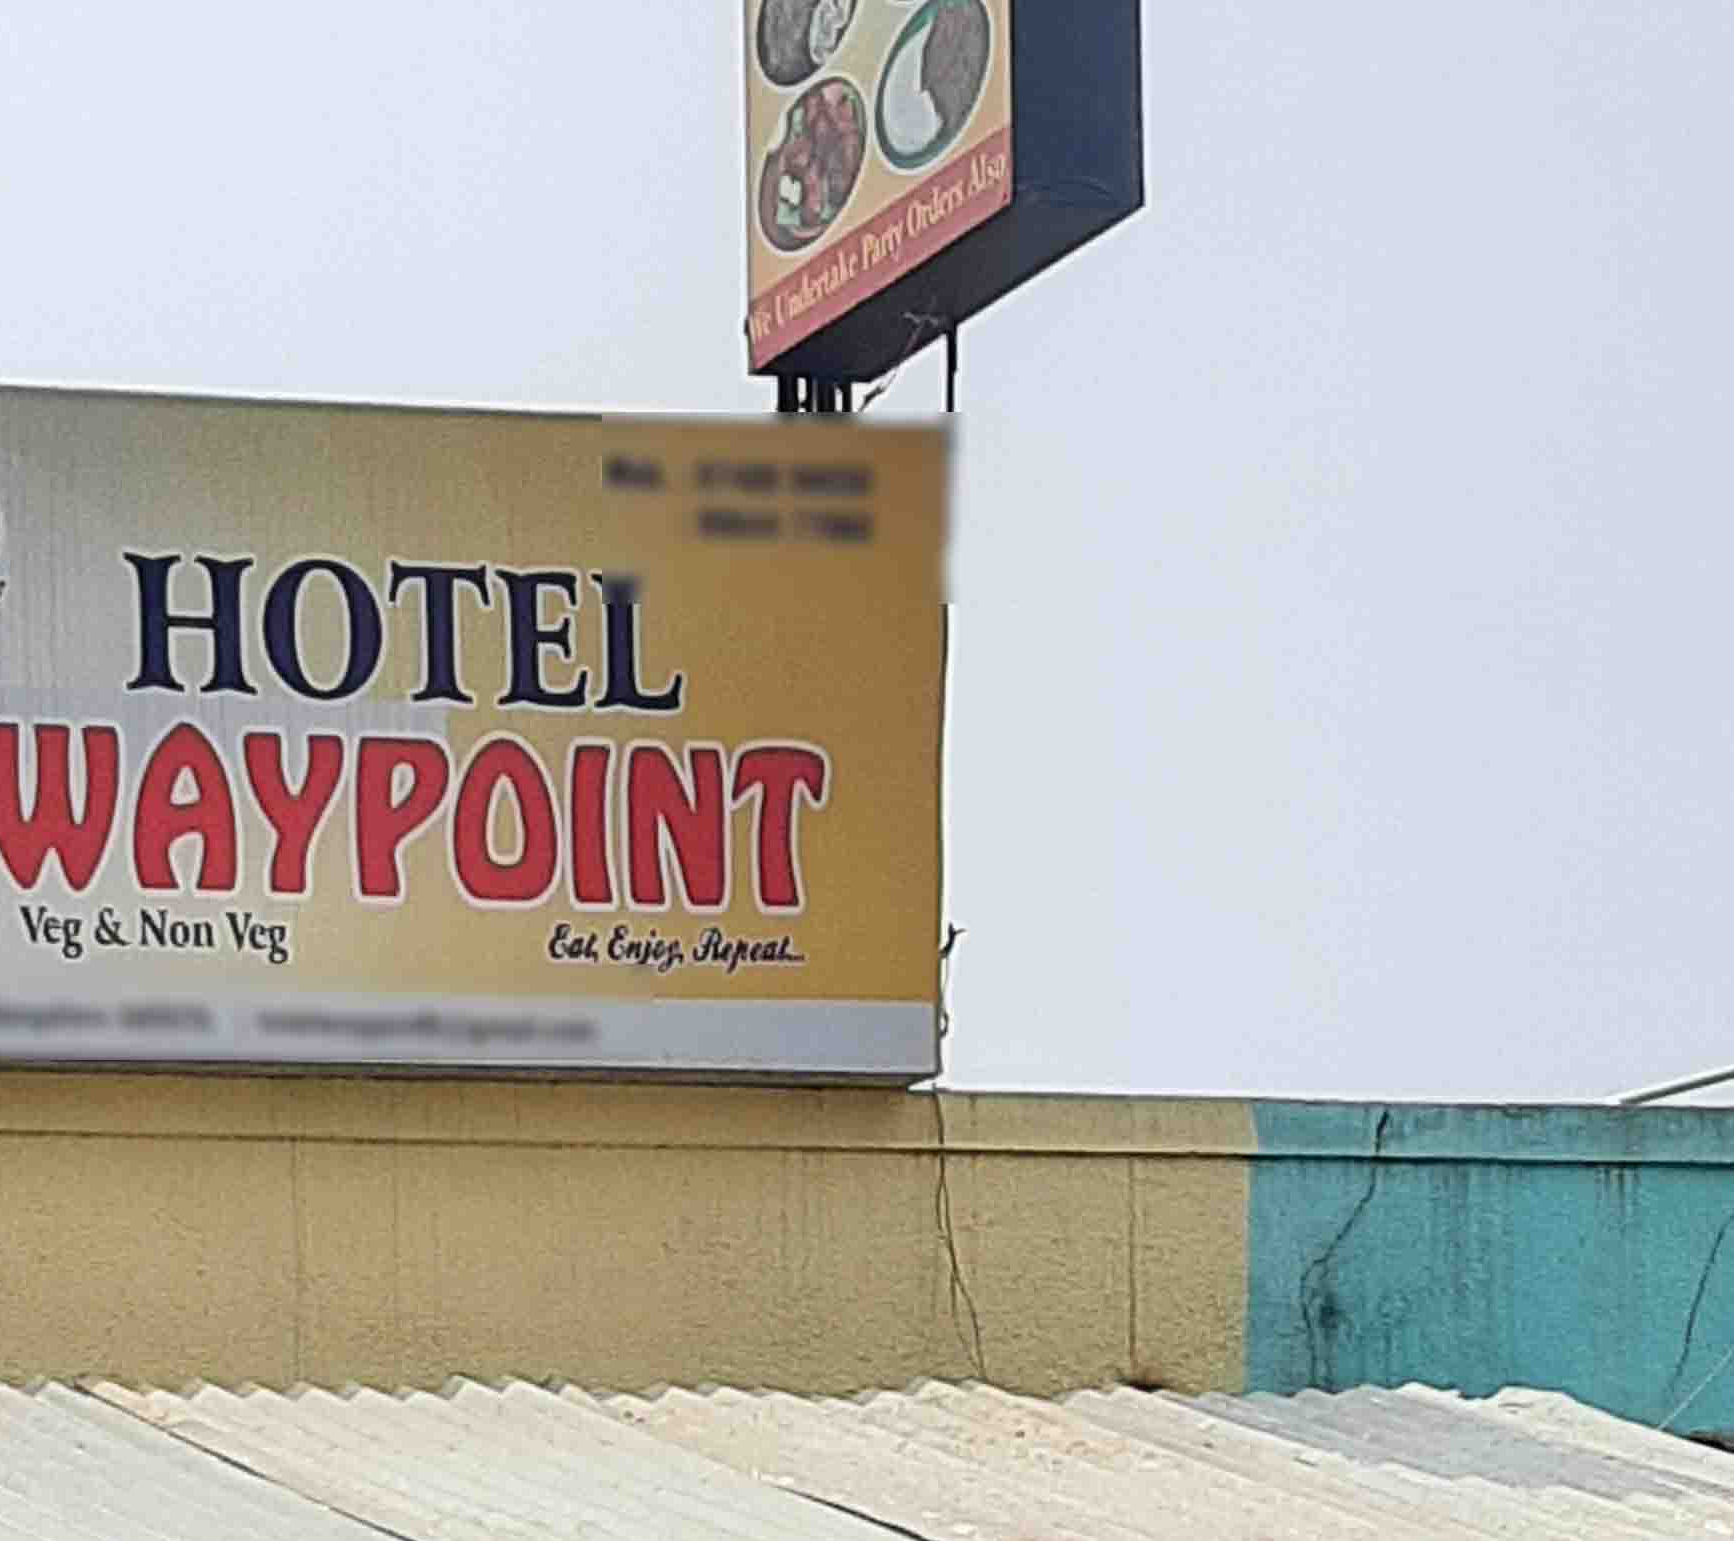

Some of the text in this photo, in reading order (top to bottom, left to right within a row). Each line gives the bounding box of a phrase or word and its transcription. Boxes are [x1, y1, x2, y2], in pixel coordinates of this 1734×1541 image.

[124, 550, 685, 711] HOTEL
[19, 905, 289, 964] Veg & Non Veg
